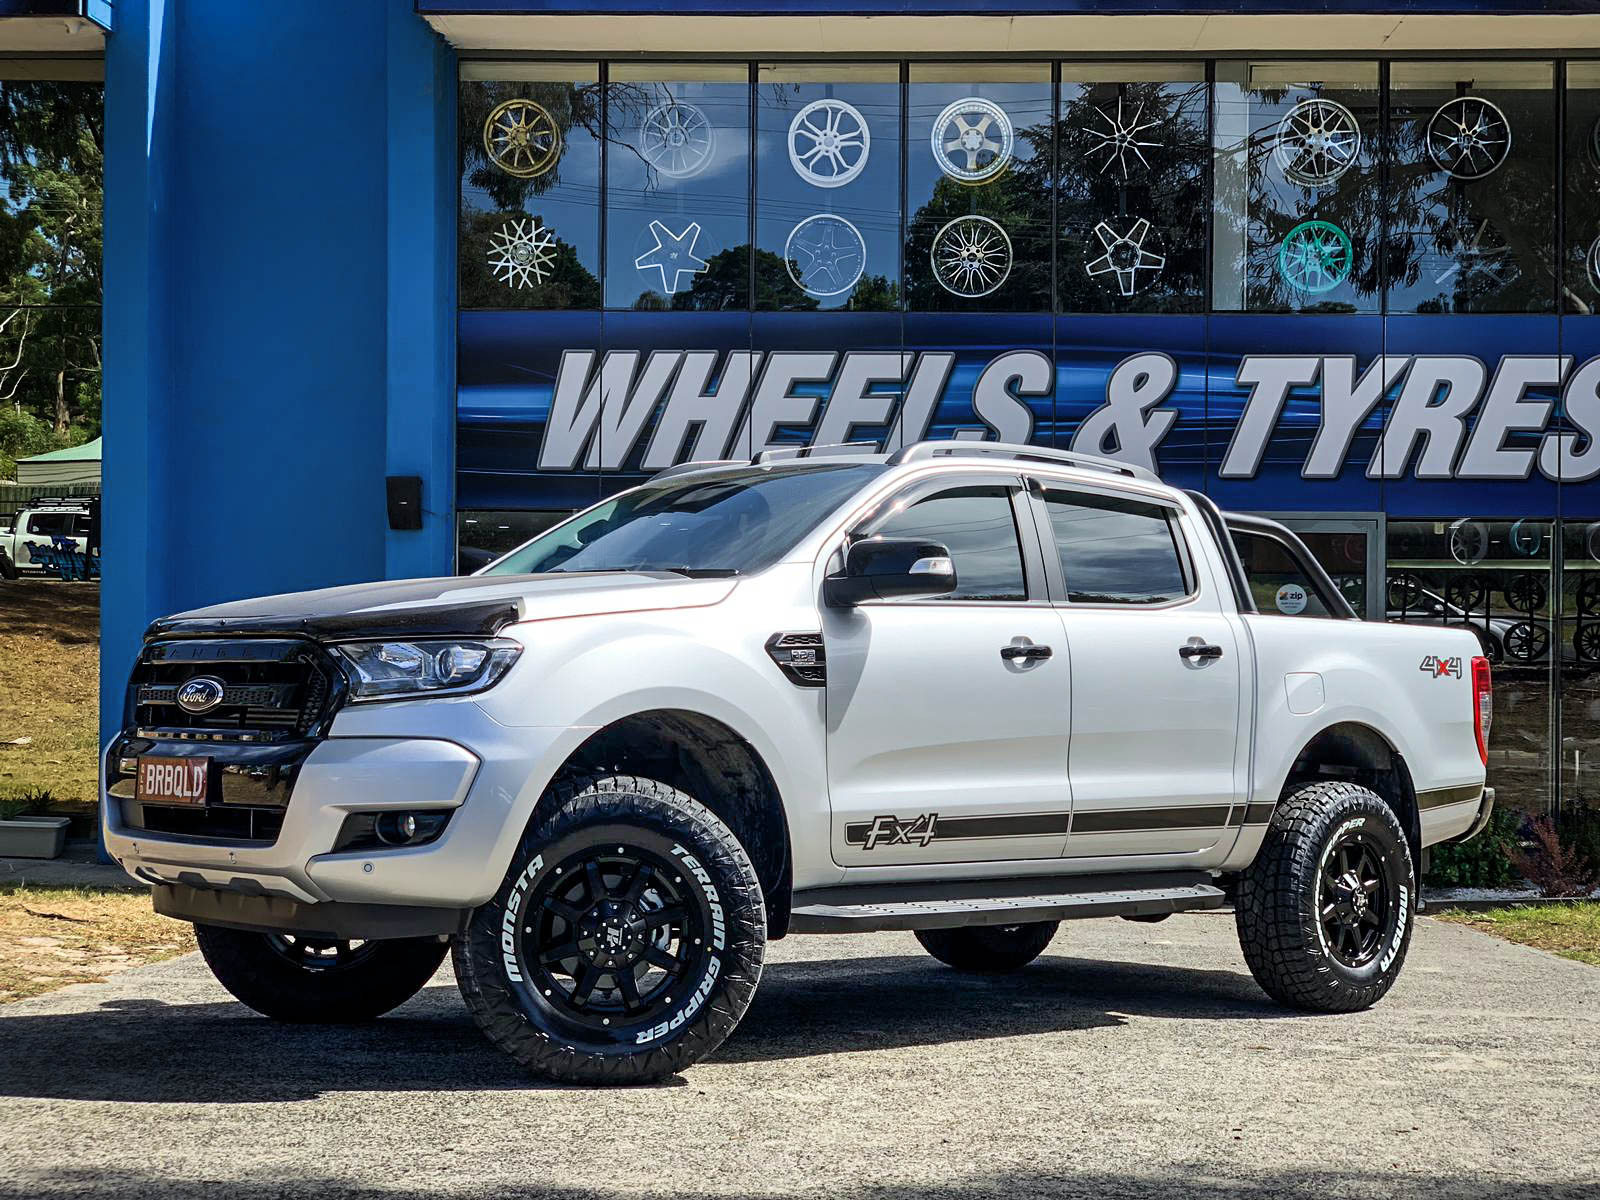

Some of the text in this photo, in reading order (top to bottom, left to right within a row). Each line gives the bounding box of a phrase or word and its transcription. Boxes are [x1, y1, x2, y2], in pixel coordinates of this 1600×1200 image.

[537, 349, 1054, 471] WHEELS
[1069, 351, 1178, 477] &
[1289, 592, 1303, 600] zip
[180, 683, 207, 702] Ford
[1419, 655, 1462, 679] 4x4
[145, 764, 203, 798] BRBQLD
[501, 854, 544, 982] MONSTA
[636, 843, 726, 1045] TERRAIN GRIPPER
[1380, 884, 1408, 972] MONSTA
